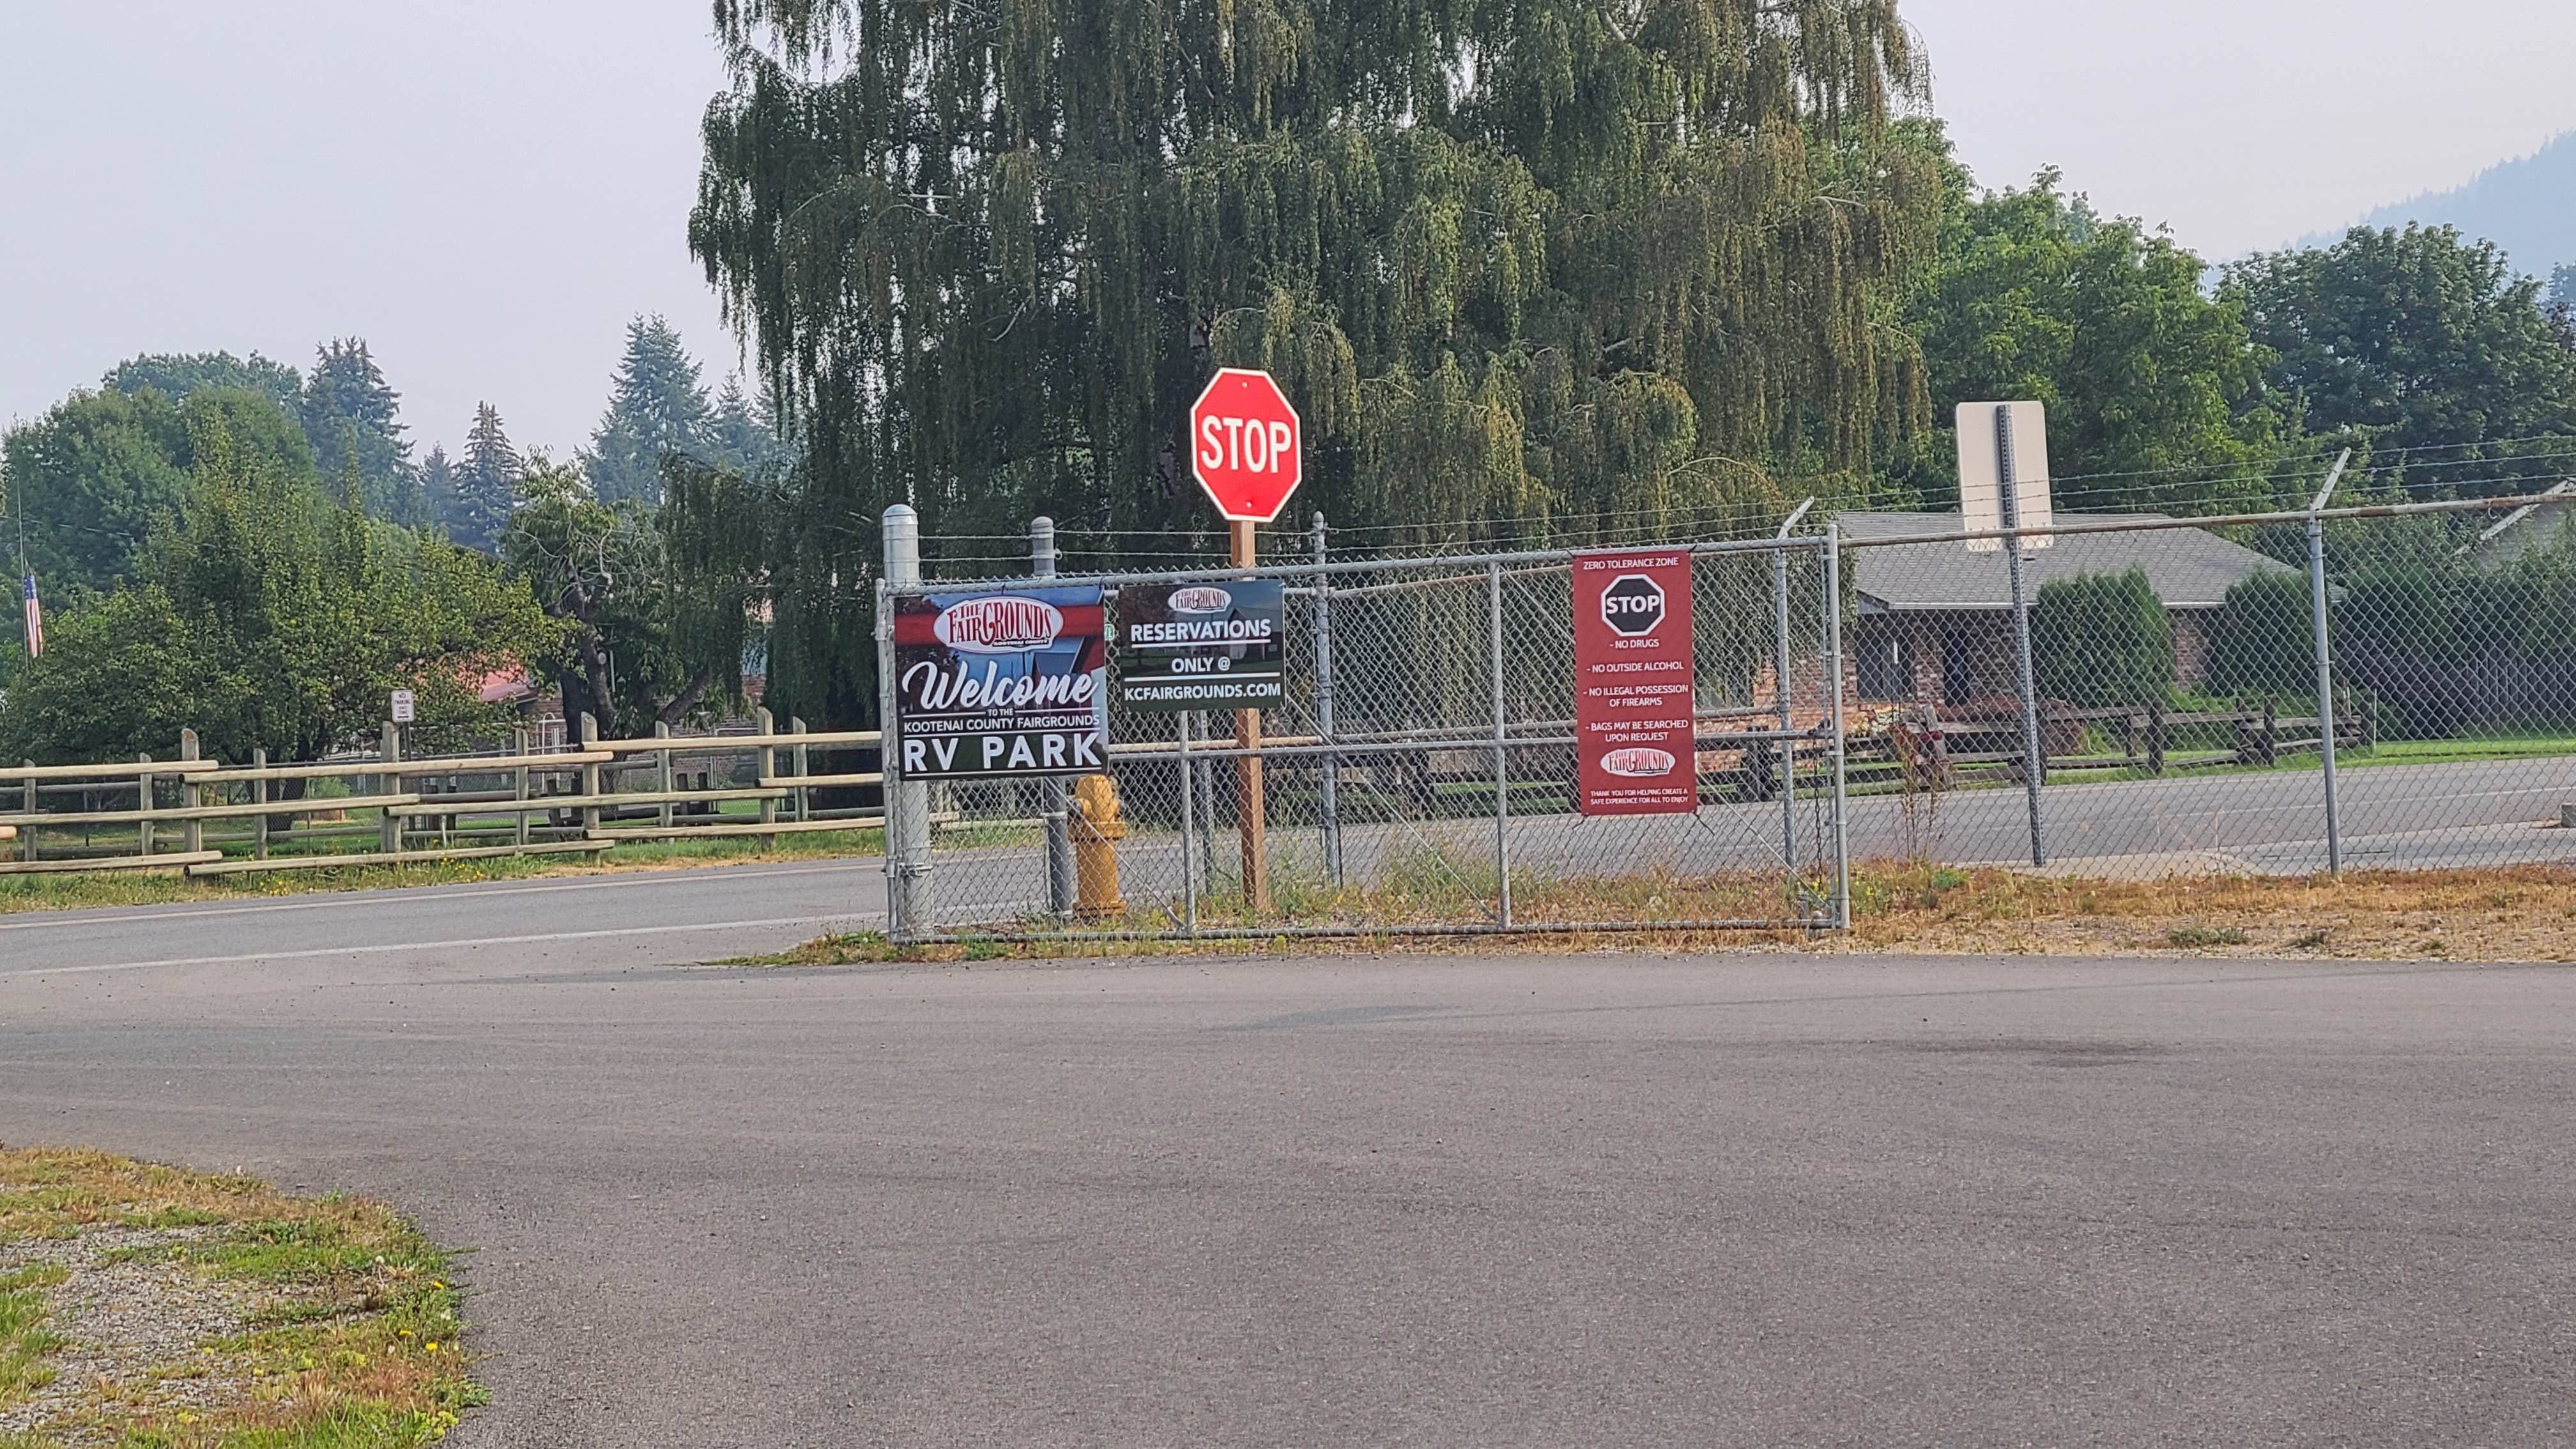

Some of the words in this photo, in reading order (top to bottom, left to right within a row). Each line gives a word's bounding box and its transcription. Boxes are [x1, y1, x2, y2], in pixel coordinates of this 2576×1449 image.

[1200, 415, 1292, 473] STOP
[1583, 561, 1606, 570] ZERO
[1607, 558, 1654, 569] TOLERANCE
[1655, 557, 1679, 566] ZONE
[958, 603, 982, 618] THE
[1606, 595, 1660, 614] STOP
[1131, 618, 1271, 641] RESERVATIONS
[1615, 640, 1629, 648] NO
[1630, 639, 1659, 648] DRUGS
[1172, 657, 1214, 673] ONLY
[1218, 656, 1230, 671] @
[1592, 664, 1605, 673] NO
[1606, 663, 1643, 671] OUTSIDE
[1644, 661, 1684, 670] ALCOHOL
[902, 661, 1098, 710] Welcome
[1124, 683, 1281, 701] KCFAIRGROUNDS.COM
[1589, 687, 1602, 696] NO
[1604, 686, 1634, 696] ILLEGAL
[1636, 685, 1689, 694] POSSESSION
[1609, 699, 1620, 707] OF
[1622, 697, 1662, 707] FIREARMS
[904, 719, 963, 733] KOOTENAI
[966, 717, 1015, 730] COUNTY
[1017, 715, 1100, 728] FAIRGROUNDS
[1591, 722, 1613, 731] BAGS
[1614, 721, 1630, 730] MAY
[1632, 721, 1642, 730] BE
[1643, 720, 1689, 729] SEARCHED
[1605, 733, 1629, 742] UPON
[1630, 732, 1669, 741] REQUEST
[904, 738, 958, 772] RV
[983, 733, 1101, 769] PARK
